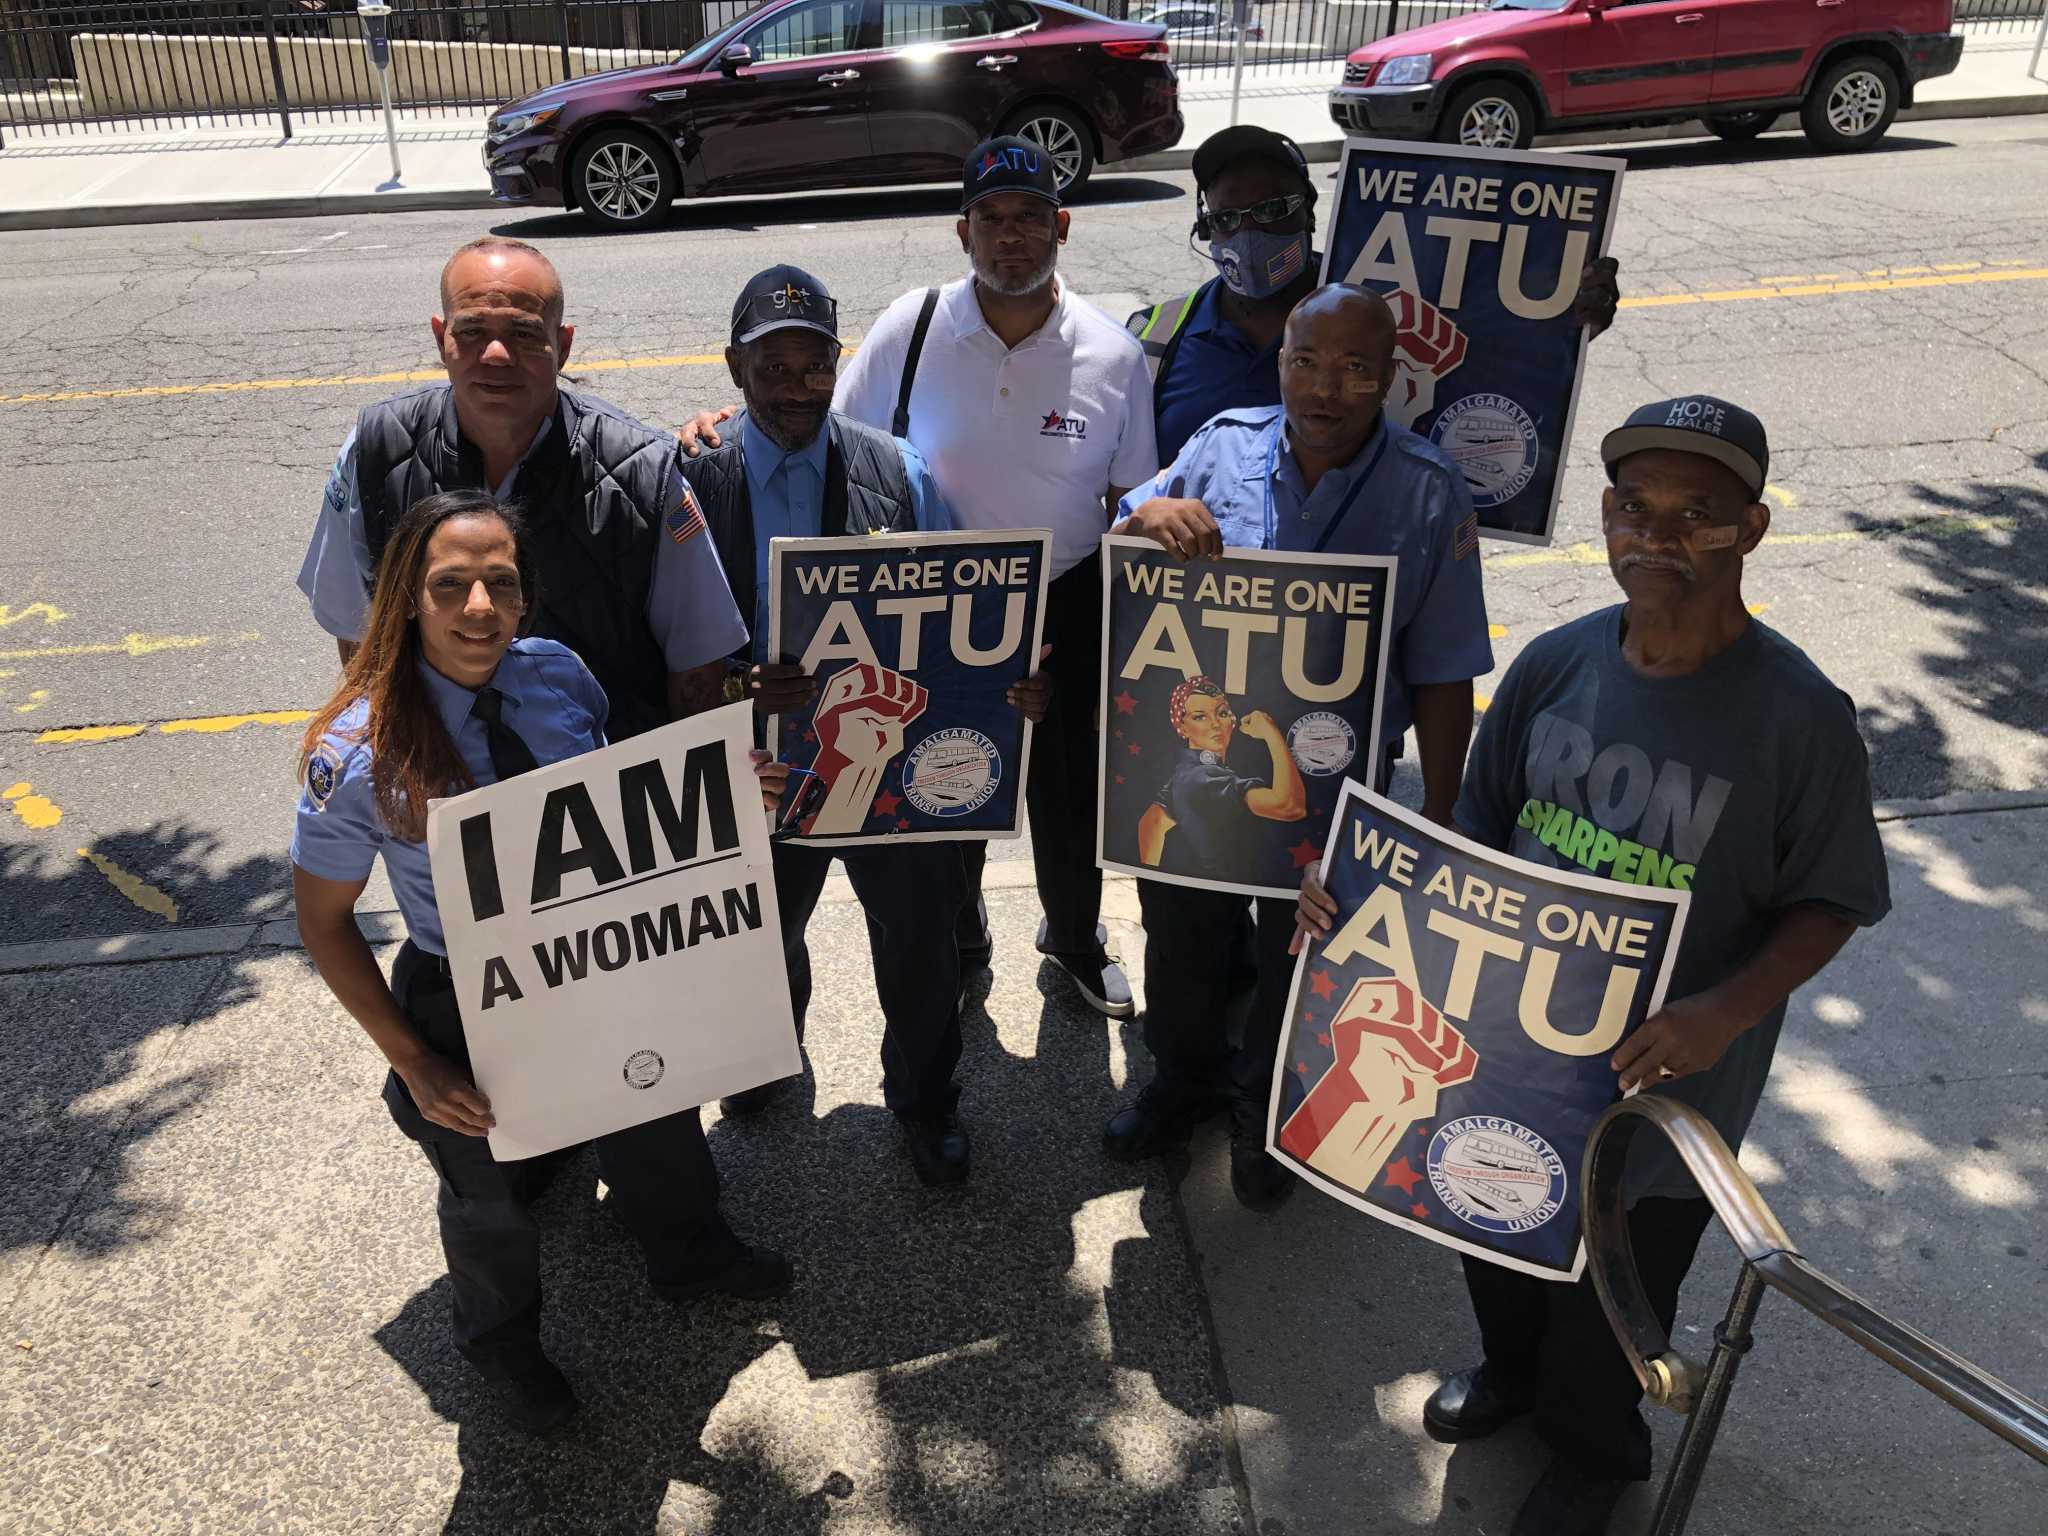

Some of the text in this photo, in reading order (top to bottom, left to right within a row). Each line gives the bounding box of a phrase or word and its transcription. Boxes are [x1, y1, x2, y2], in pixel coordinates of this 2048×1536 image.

[997, 147, 1040, 174] ATU
[1358, 168, 1598, 221] WE ARE ONE
[1344, 211, 1591, 320] ATU
[1056, 418, 1086, 434] ATU
[1437, 396, 1535, 440] AMALGAMATED
[1664, 417, 1720, 436] DEALER
[1669, 401, 1725, 426] HOPE
[1493, 464, 1533, 503] UNION
[795, 556, 1031, 595] WE ARE ONE
[1123, 561, 1372, 614] WE ARE ONE
[800, 592, 1027, 676] ATU
[1119, 602, 1369, 703] ATU
[909, 729, 997, 765] AMALGAMATED
[905, 781, 944, 815] TRANSIT
[966, 777, 998, 810] UNION
[460, 739, 740, 922] I AM
[1517, 798, 1696, 891] SHARPENS
[1352, 818, 1654, 959] WE ARE ONE
[481, 882, 763, 1011] A WOMAN
[1321, 883, 1641, 1057] ATU
[1440, 1119, 1562, 1175] AMALGAMATED
[1429, 1162, 1473, 1218] TRANSIT
[1507, 1199, 1559, 1231] UNION
